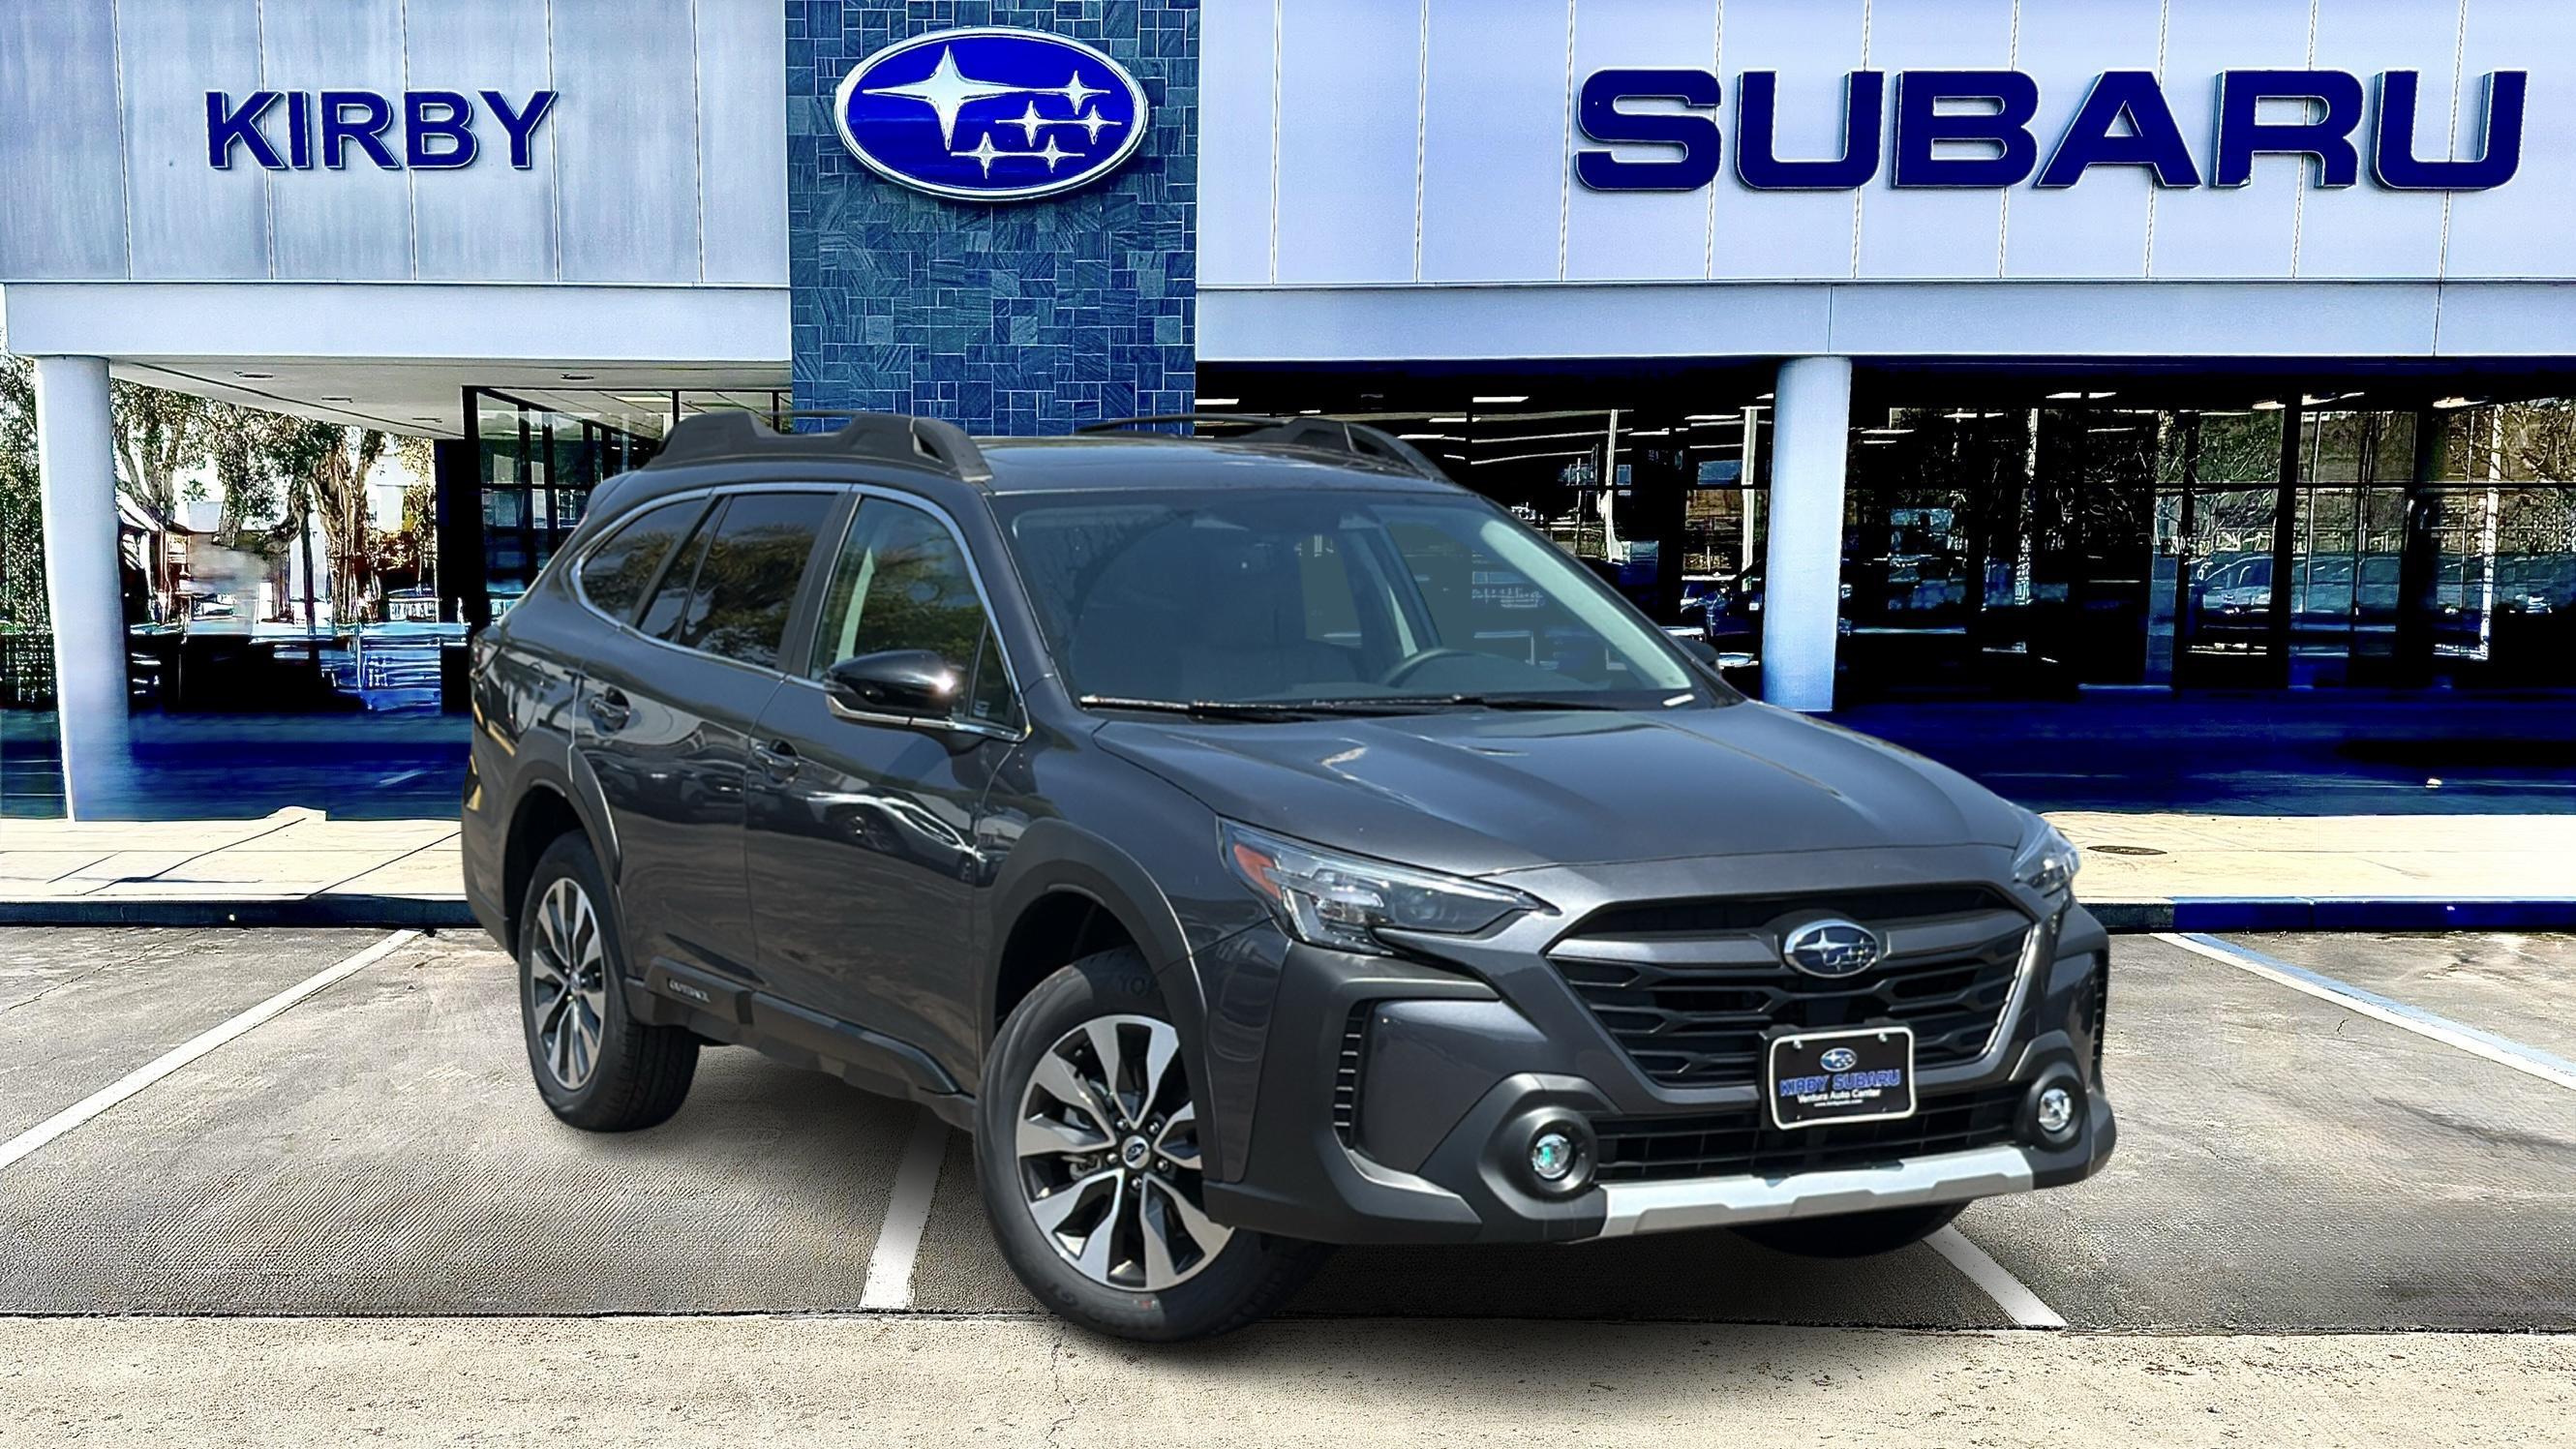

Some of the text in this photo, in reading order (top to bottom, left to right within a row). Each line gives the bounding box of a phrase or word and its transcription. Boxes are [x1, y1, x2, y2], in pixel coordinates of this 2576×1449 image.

[204, 89, 559, 170] KIRBY
[1575, 68, 2529, 192] SUBARU
[1779, 1069, 1901, 1098] KIRBY SUBARU
[1797, 1093, 1829, 1103] Ventura
[1830, 1090, 1850, 1101] Auto
[1851, 1088, 1882, 1099] Center
